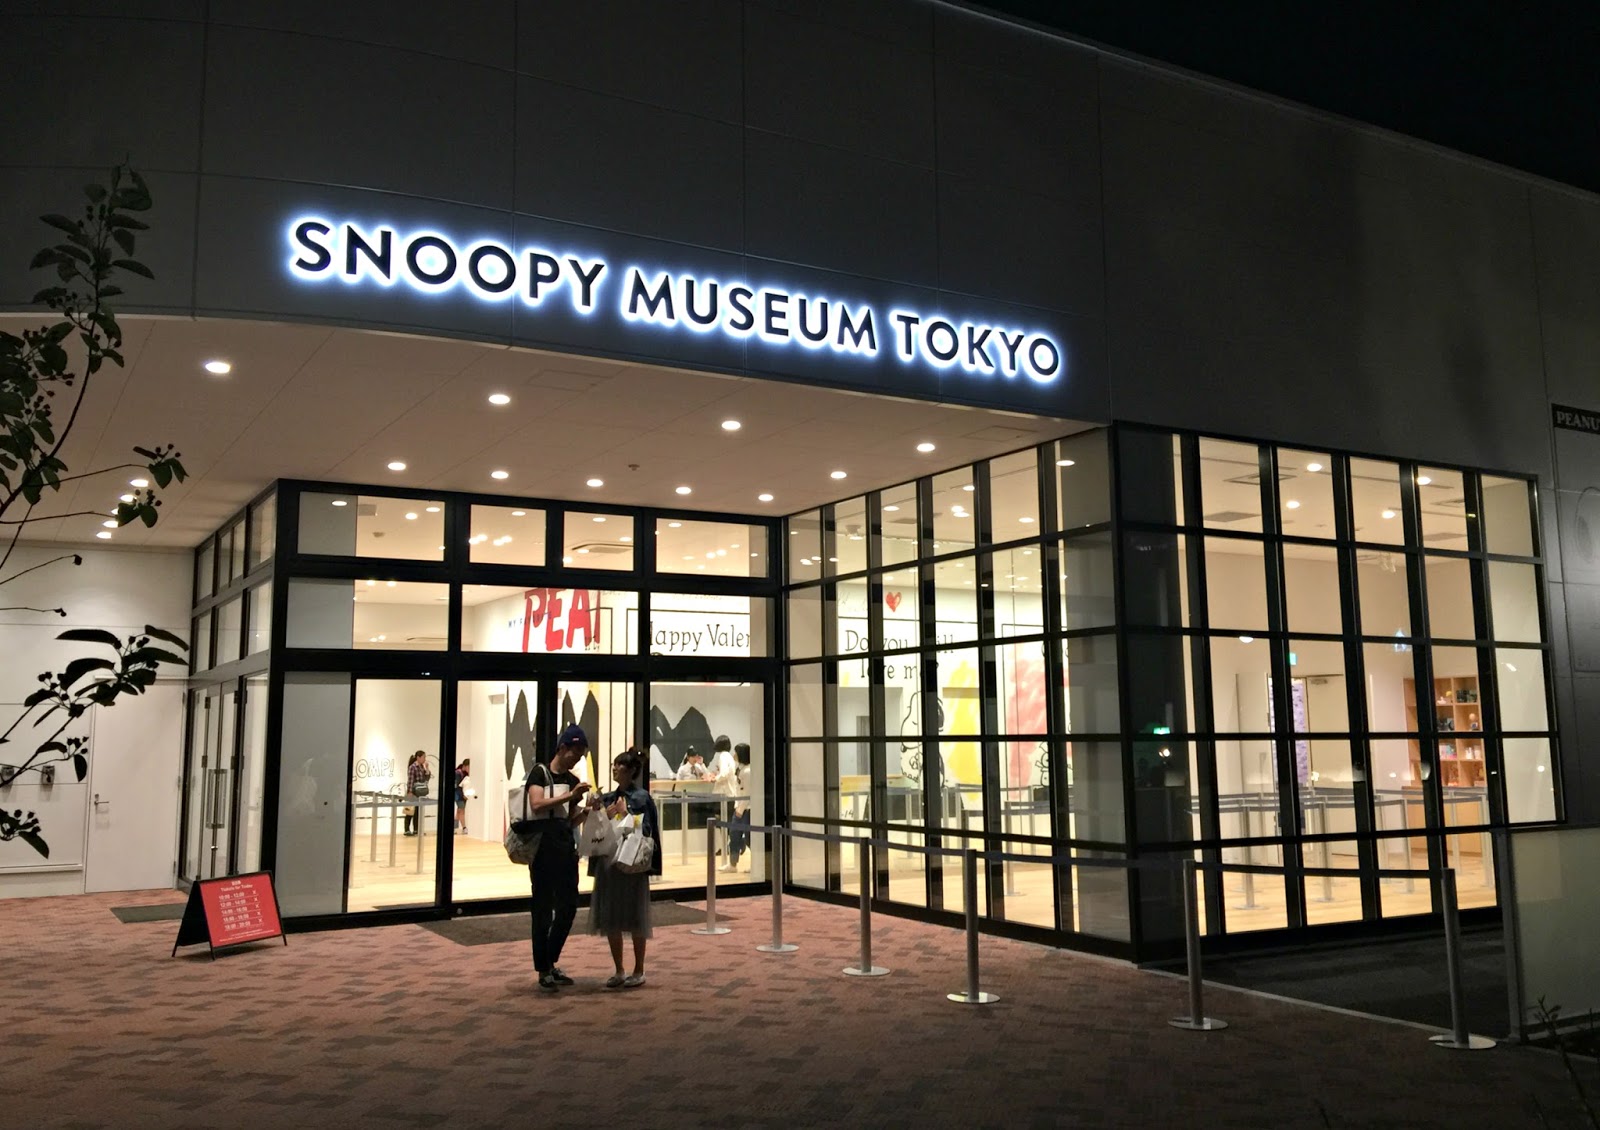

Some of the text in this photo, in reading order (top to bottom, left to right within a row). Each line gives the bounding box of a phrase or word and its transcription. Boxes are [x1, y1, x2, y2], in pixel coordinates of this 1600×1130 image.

[295, 221, 1059, 377] SNOOPY MUSEUM TOKYO
[845, 630, 869, 651] Do
